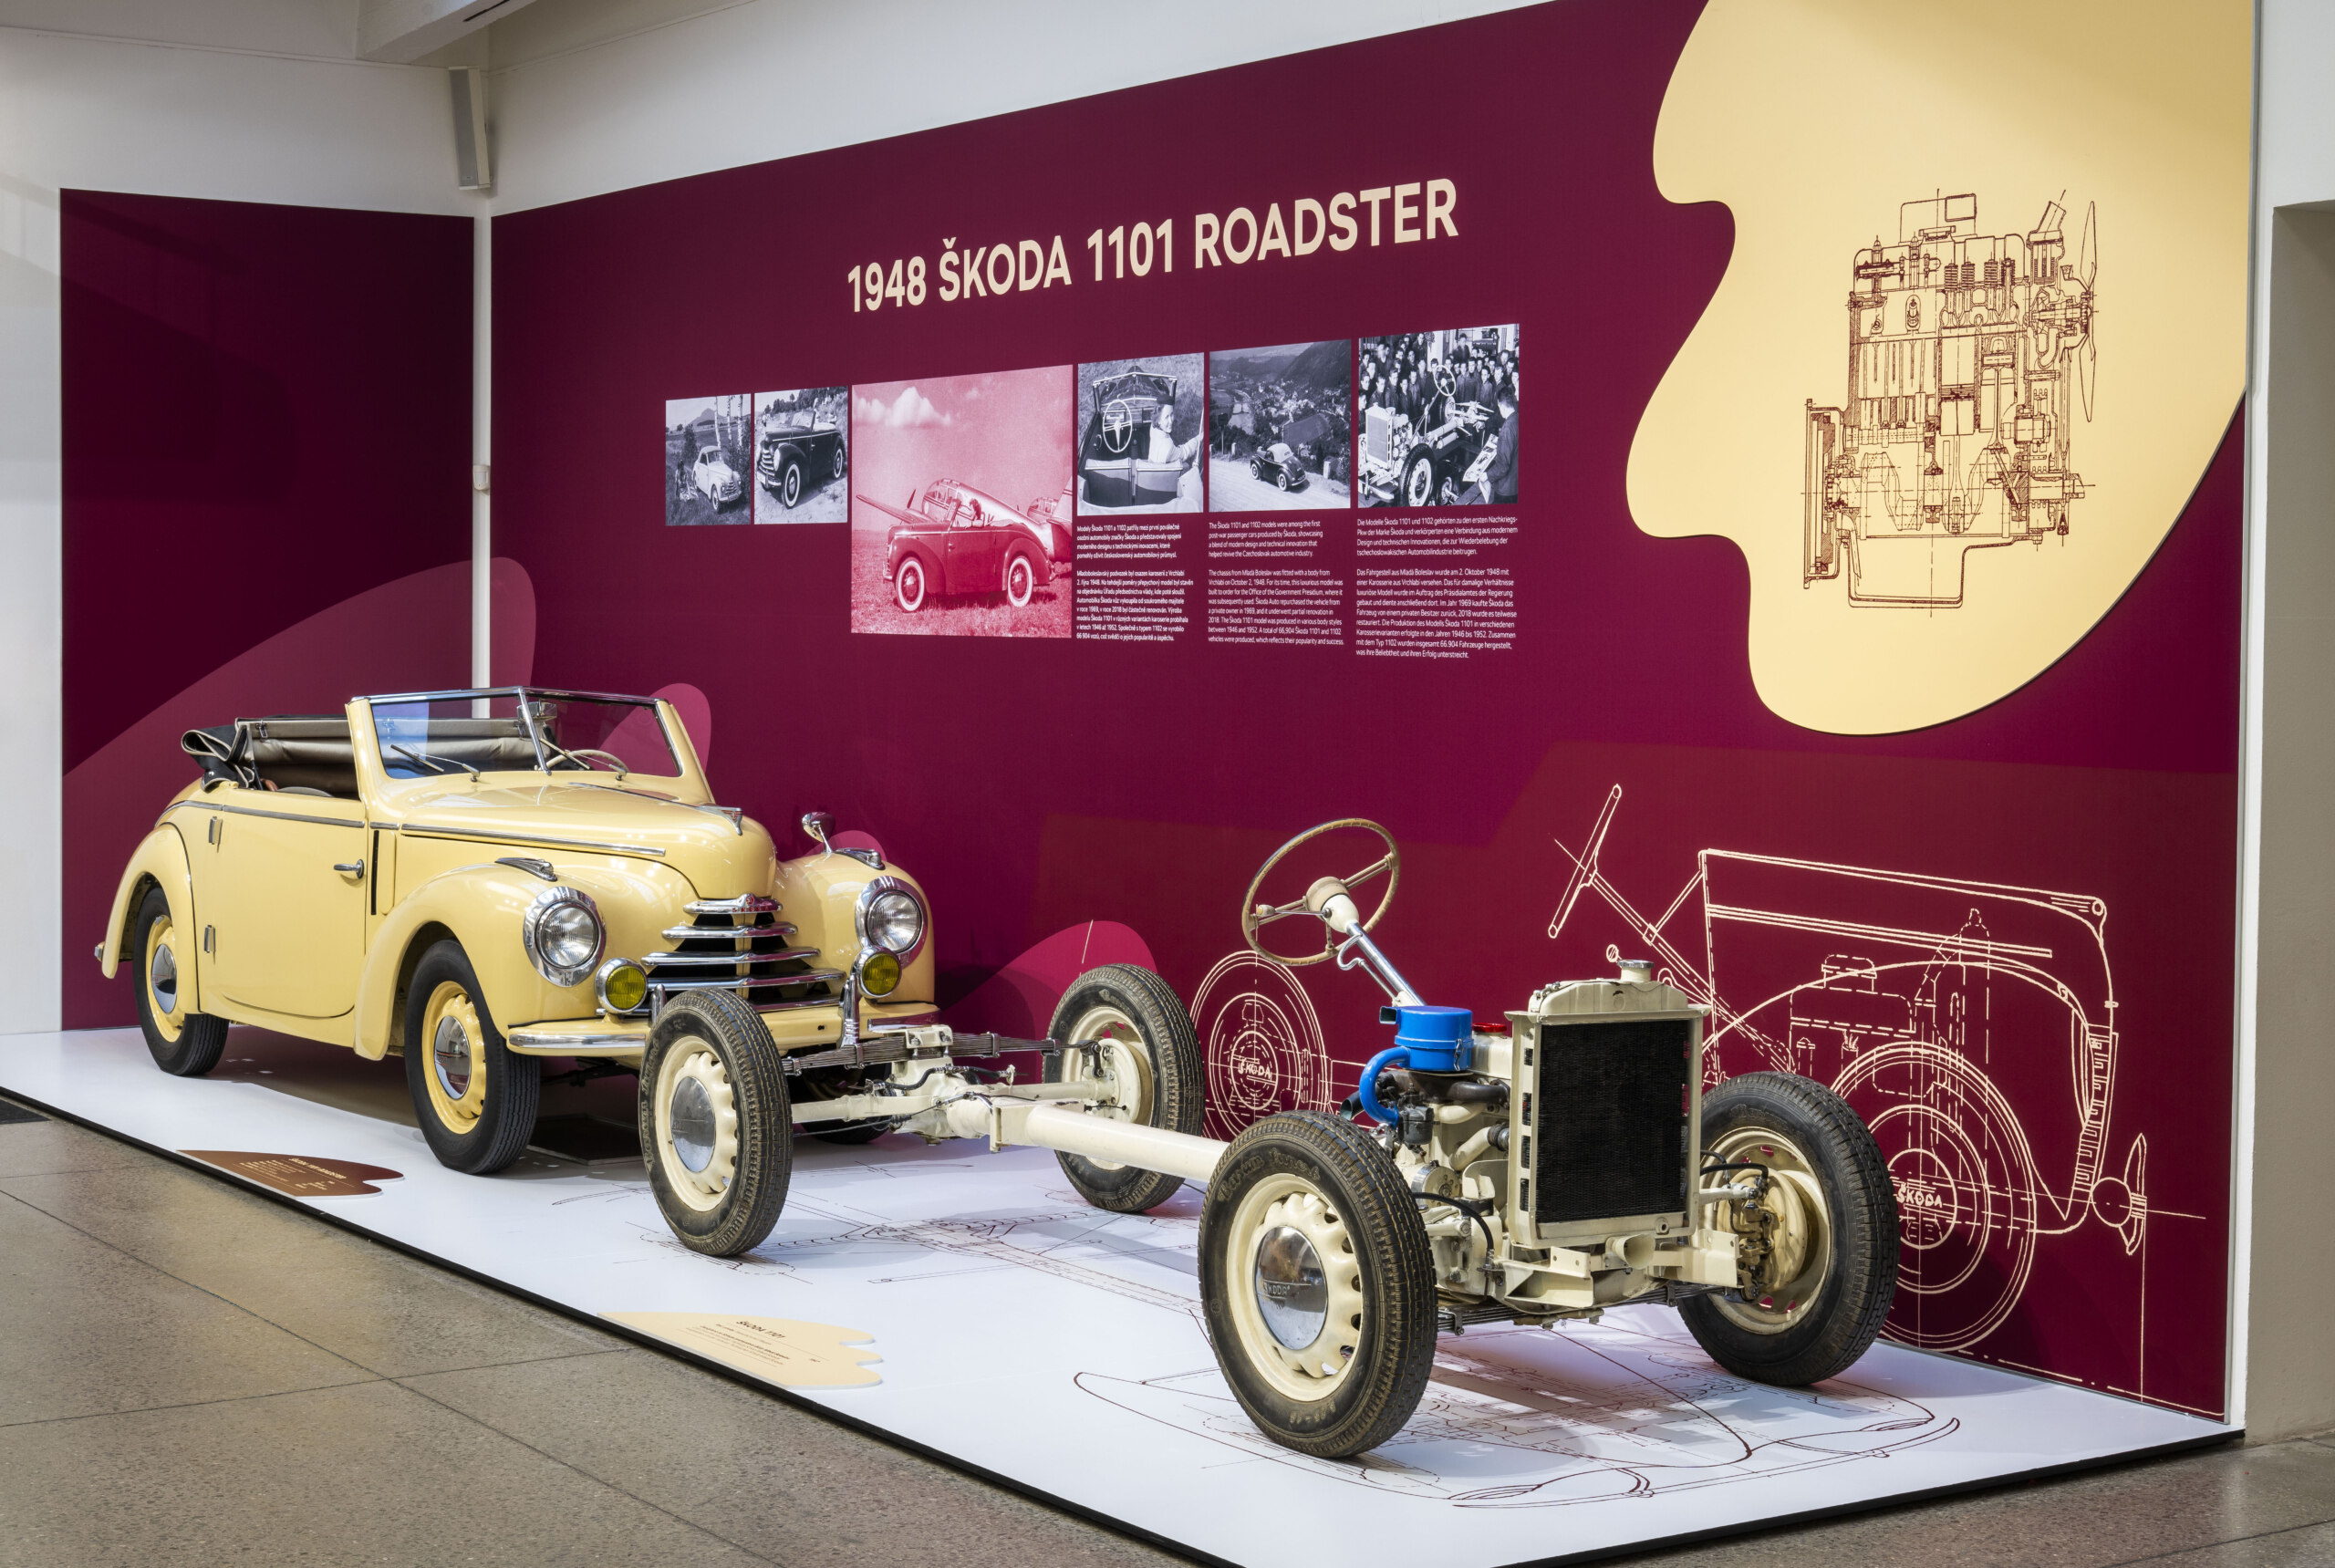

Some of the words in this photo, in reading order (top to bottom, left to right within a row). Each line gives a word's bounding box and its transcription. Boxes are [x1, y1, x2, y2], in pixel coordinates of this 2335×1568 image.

[848, 256, 926, 312] 1948
[939, 235, 1072, 301] ŠKODA
[1088, 219, 1172, 281] 1101
[1196, 179, 1458, 268] ROADSTER
[1217, 520, 1230, 528] Škoda
[1434, 517, 1455, 525] gehörten
[1489, 516, 1518, 524] Nachkriegs-
[1209, 532, 1226, 540] post-war
[1257, 531, 1276, 539] produced
[1298, 530, 1323, 538] showcasing
[1454, 527, 1481, 535] Verbindung
[1357, 538, 1372, 546] Design
[1458, 537, 1498, 545] Wiederbelebung
[1366, 568, 1390, 576] Fahrgestell
[1461, 579, 1483, 587] damalige
[1416, 589, 1433, 597] Auftrag
[1488, 589, 1512, 597] Regierung
[1489, 598, 1503, 607] Škoda
[1401, 609, 1419, 618] privaten
[1401, 629, 1418, 638] erfolgte
[1375, 639, 1384, 648] Typ
[1416, 640, 1439, 649] insgesamt
[1458, 641, 1483, 649] Fahrzeuge
[1422, 650, 1436, 659] Erfolg
[1896, 1182, 1943, 1209] ŠKODA
